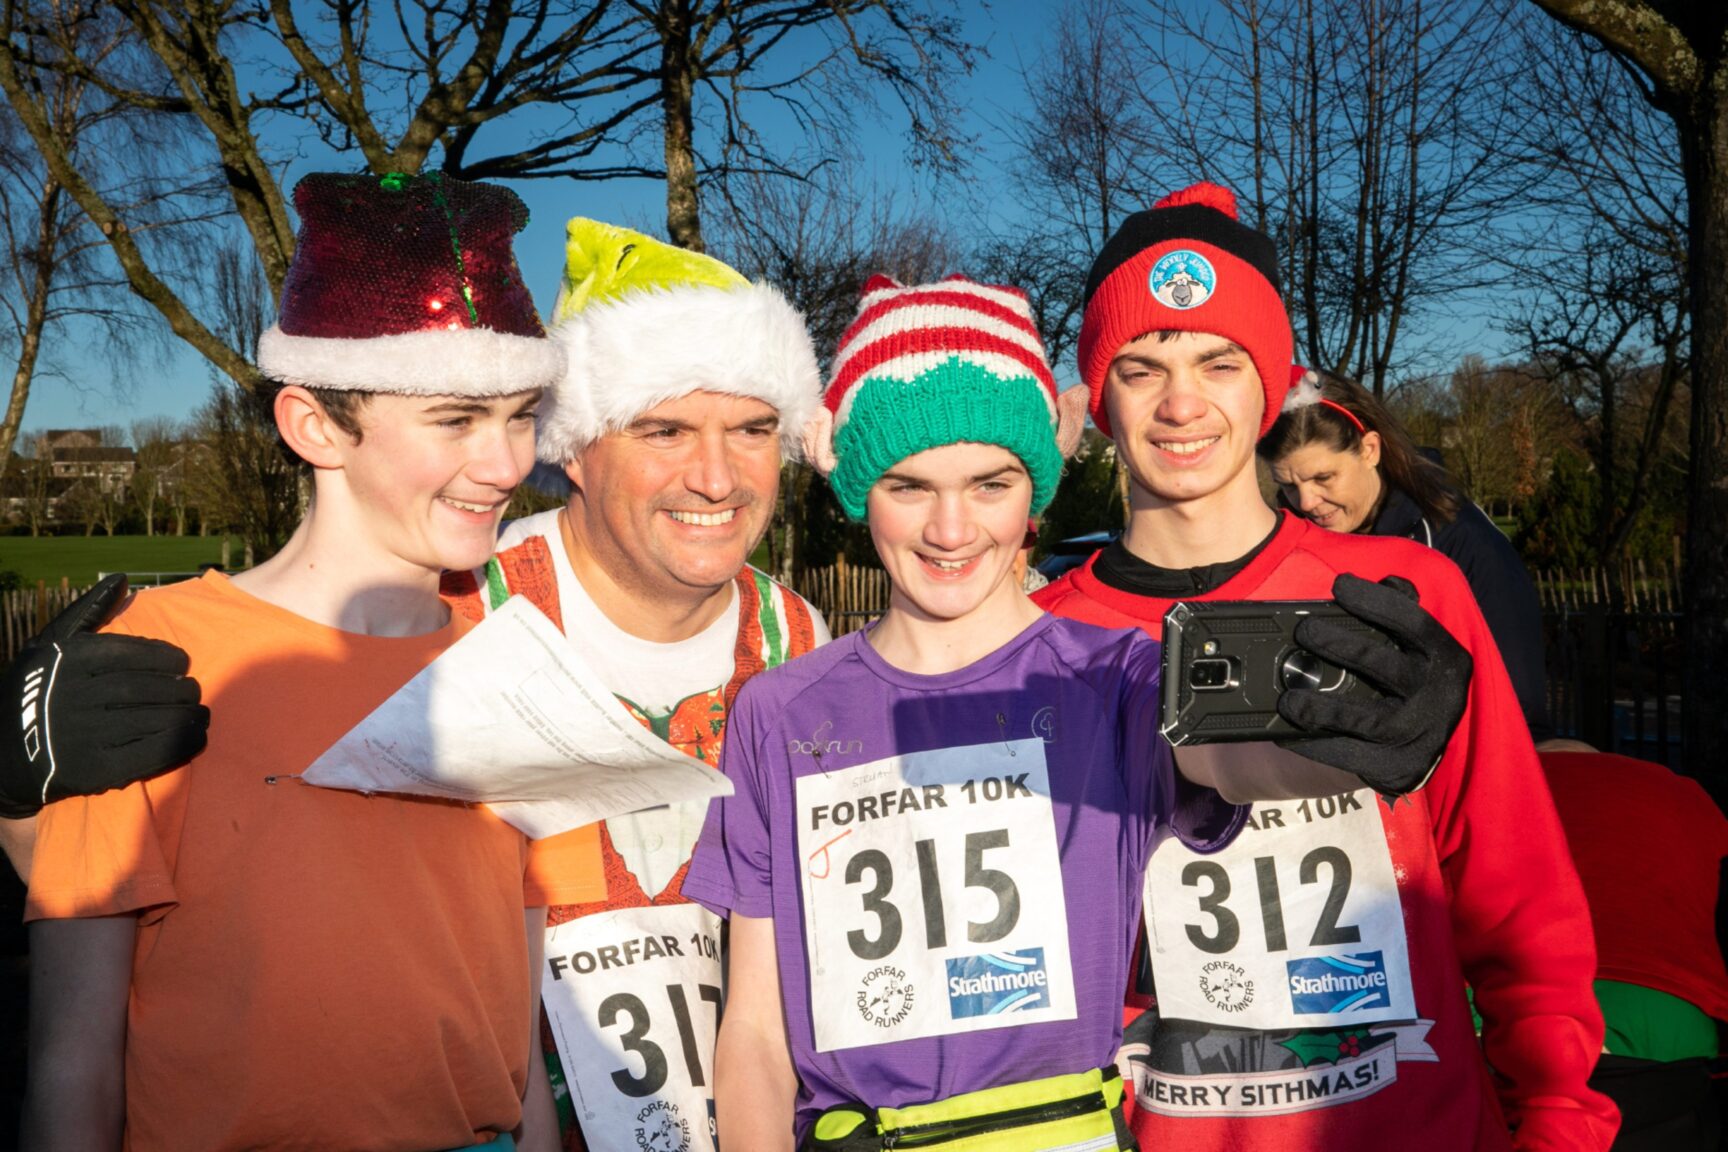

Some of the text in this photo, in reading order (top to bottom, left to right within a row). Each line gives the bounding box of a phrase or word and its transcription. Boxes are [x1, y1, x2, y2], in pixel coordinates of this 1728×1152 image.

[811, 773, 1033, 831] FORFAR 10K
[1296, 793, 1363, 823] 10K
[845, 829, 1021, 960] 315
[1181, 846, 1361, 954] 312
[548, 932, 720, 981] FORFAR 10K
[1202, 960, 1245, 977] FORFAR
[862, 965, 906, 987] FORFAR
[949, 969, 1046, 999] Strathmore
[1199, 975, 1254, 1013] ROAD RUNNERS
[1290, 968, 1386, 996] Strathmore
[857, 984, 914, 1028] ROAD RUNNERS
[1143, 1059, 1379, 1107] MERRY SITHMAS!
[637, 1100, 679, 1124] FORFAR
